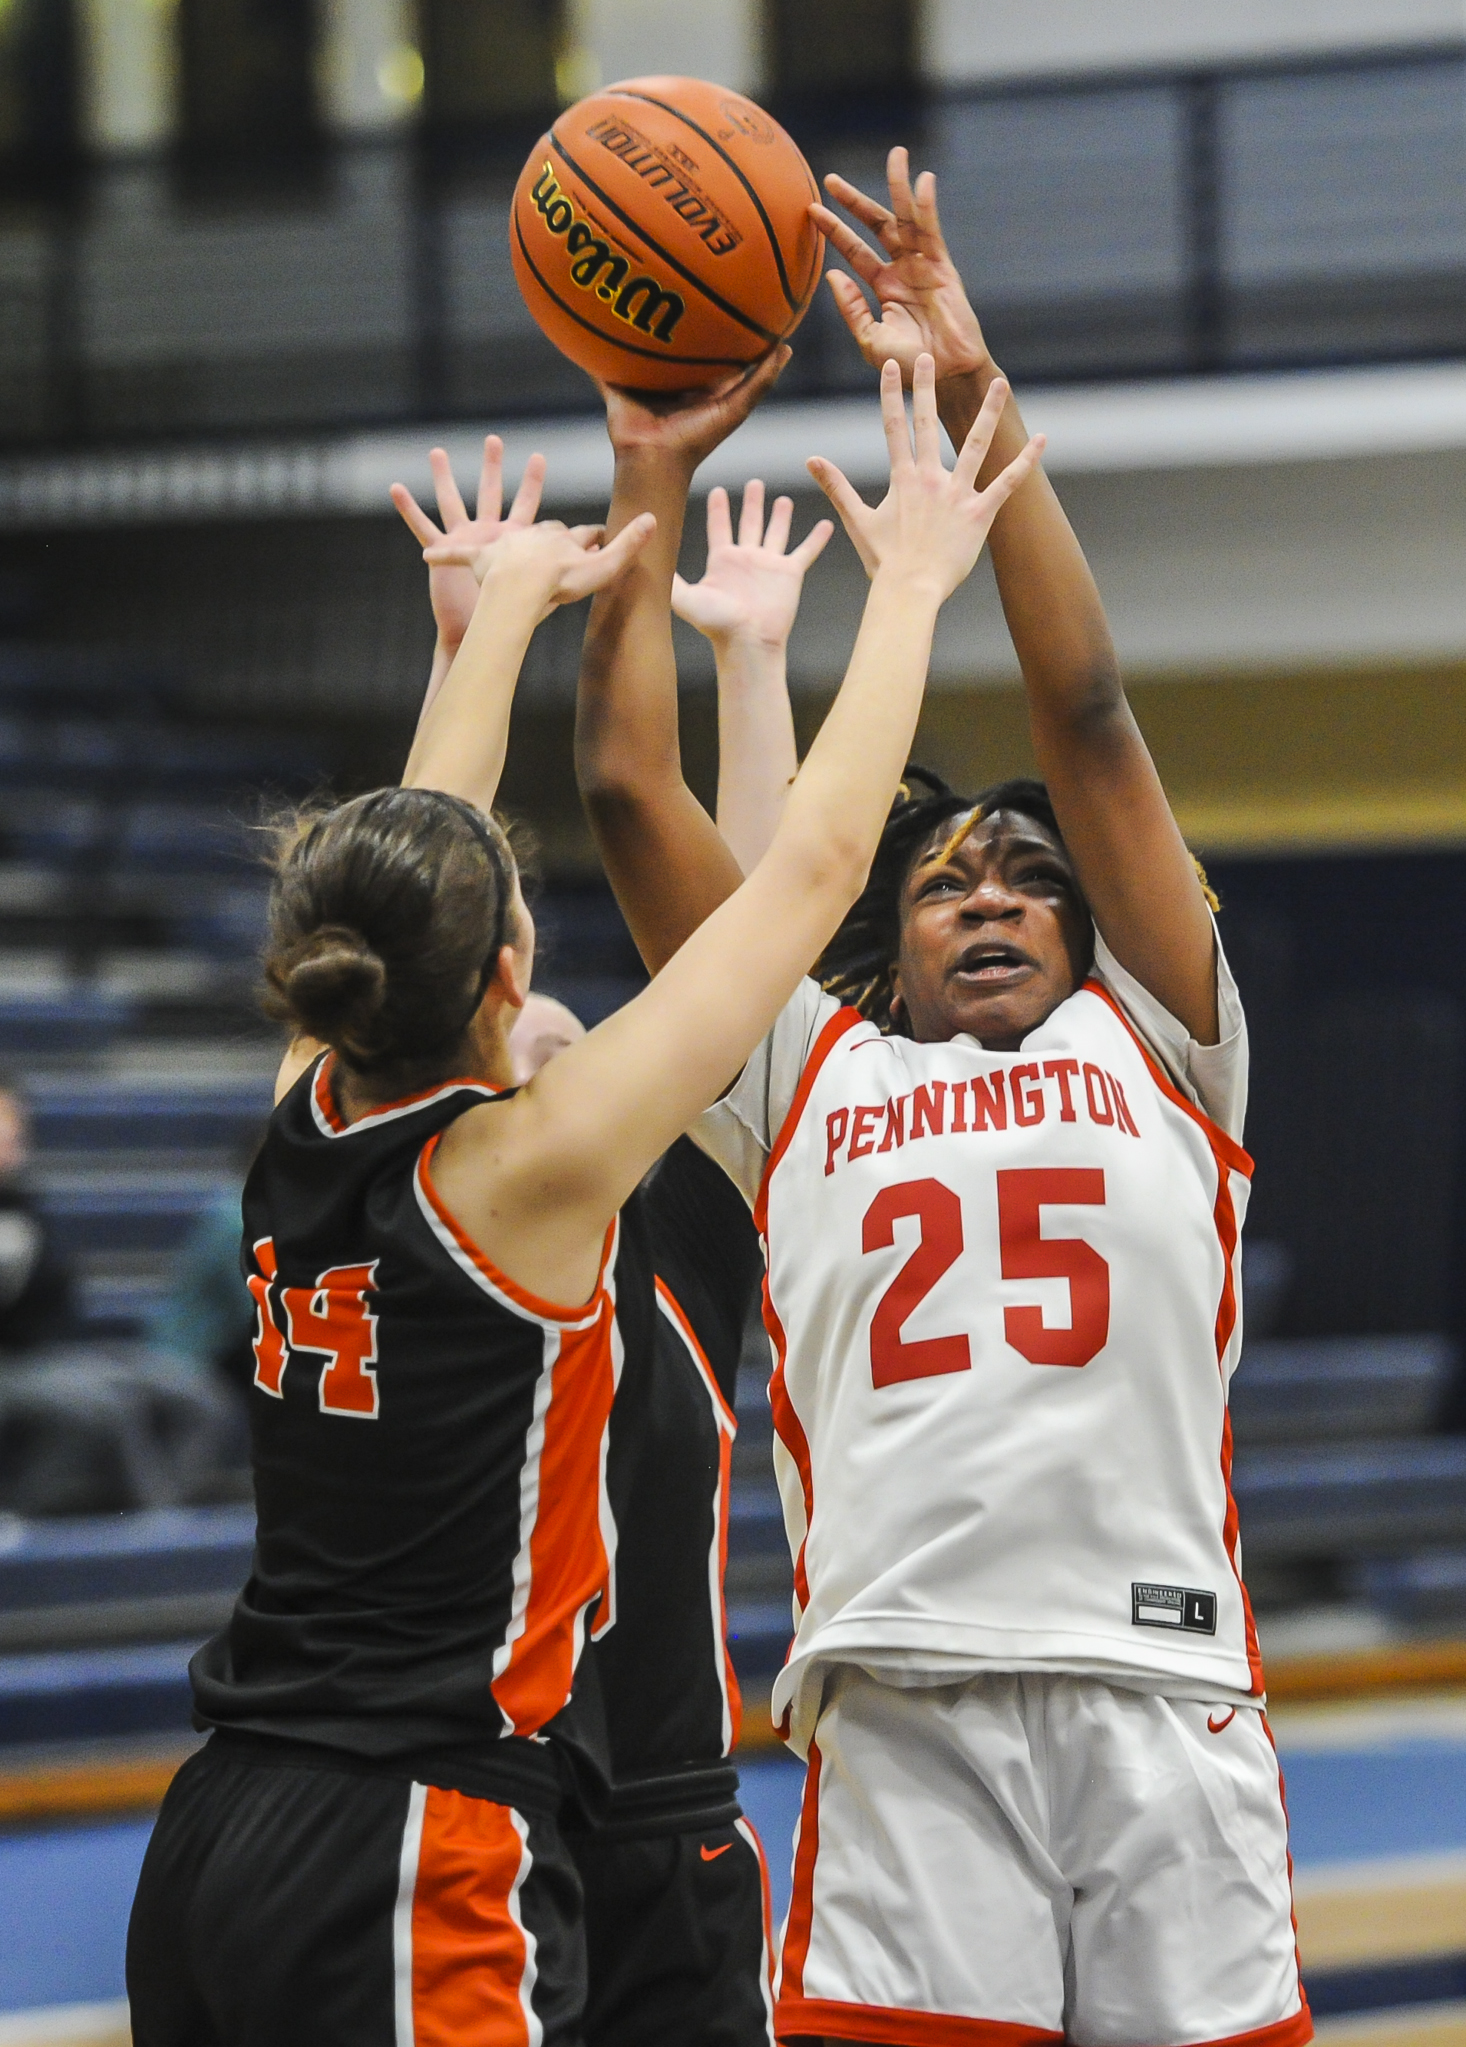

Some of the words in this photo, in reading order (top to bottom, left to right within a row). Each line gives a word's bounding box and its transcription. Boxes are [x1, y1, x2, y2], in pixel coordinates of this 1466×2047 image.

[530, 160, 686, 344] Wilson
[586, 120, 738, 256] EVOLUTION
[824, 1058, 1141, 1177] PENNINGTON
[247, 1236, 380, 1420] 14
[861, 1167, 1110, 1391] 25
[1194, 1601, 1205, 1621] L
